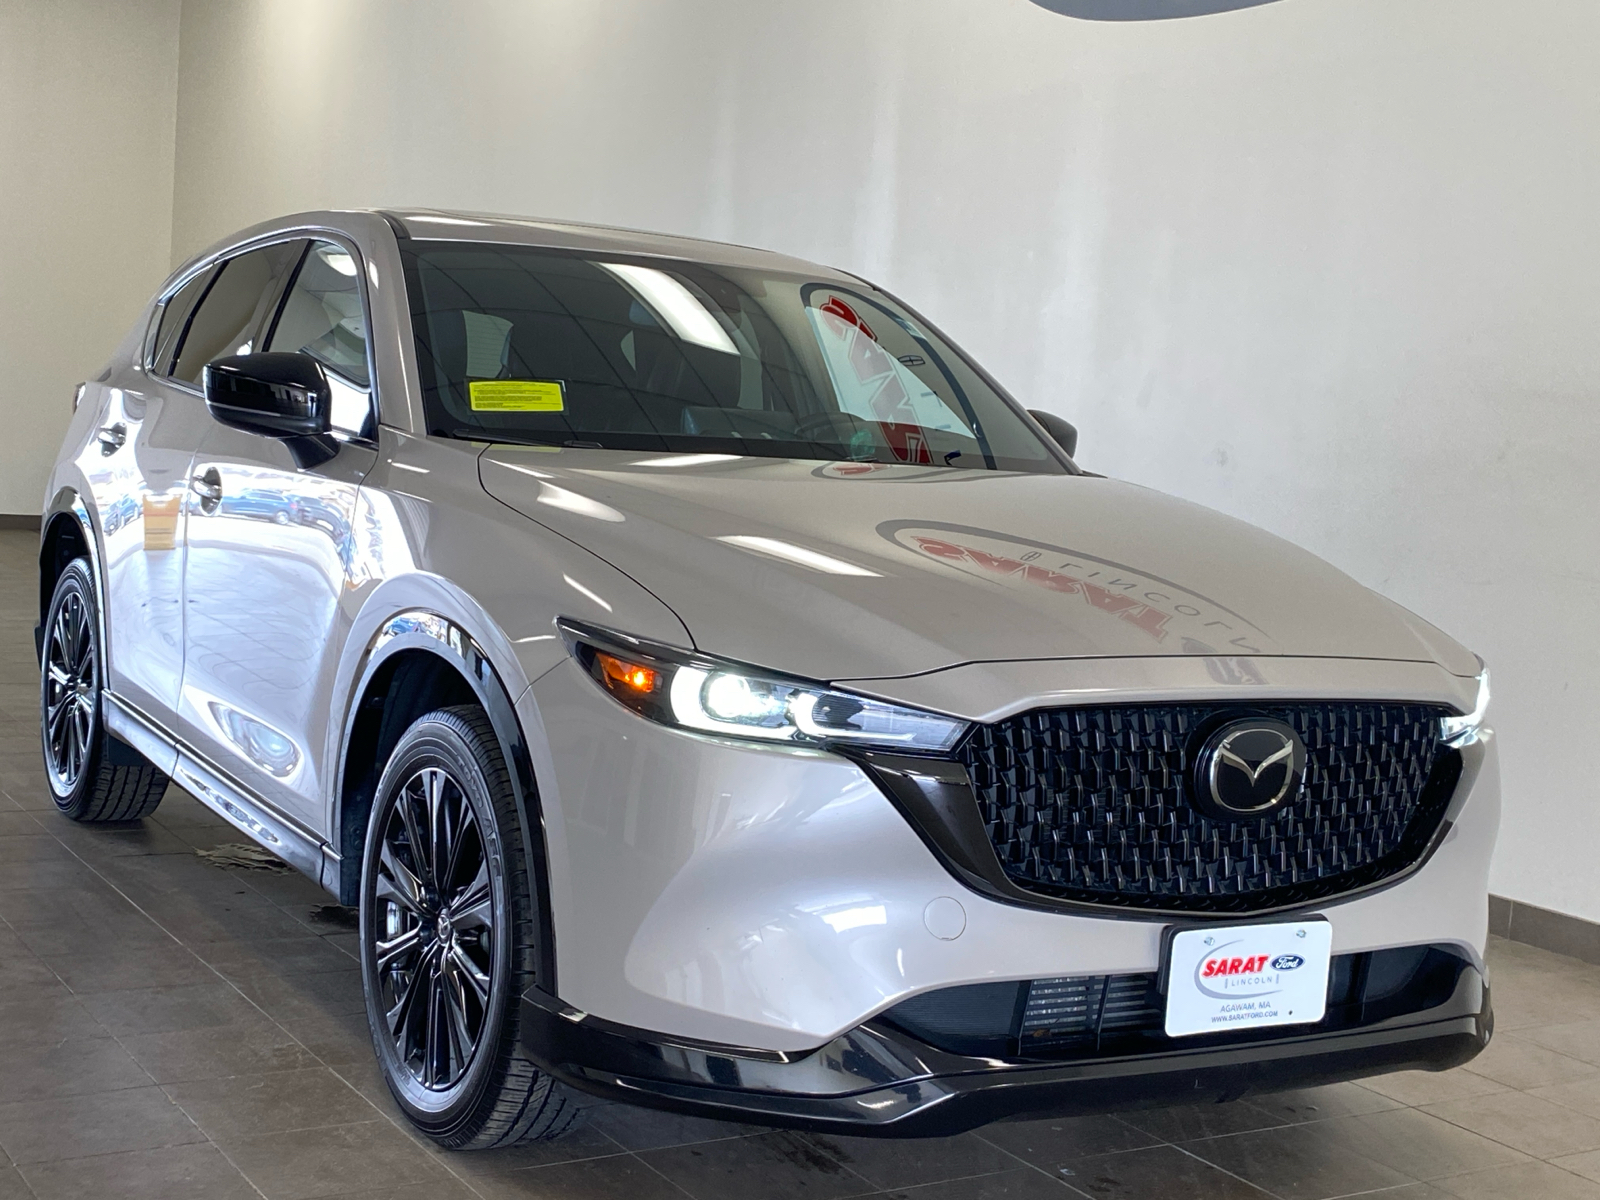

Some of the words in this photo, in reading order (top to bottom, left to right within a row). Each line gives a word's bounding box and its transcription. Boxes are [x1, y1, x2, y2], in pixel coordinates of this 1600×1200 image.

[1202, 954, 1270, 977] SARAT
[1273, 955, 1301, 969] Ford
[1231, 976, 1273, 987] LINCOLN
[1220, 1002, 1257, 1013] AGAWAM,
[1258, 1001, 1271, 1009] MA
[1211, 1010, 1278, 1023] WWW.SARATFORD.COM
